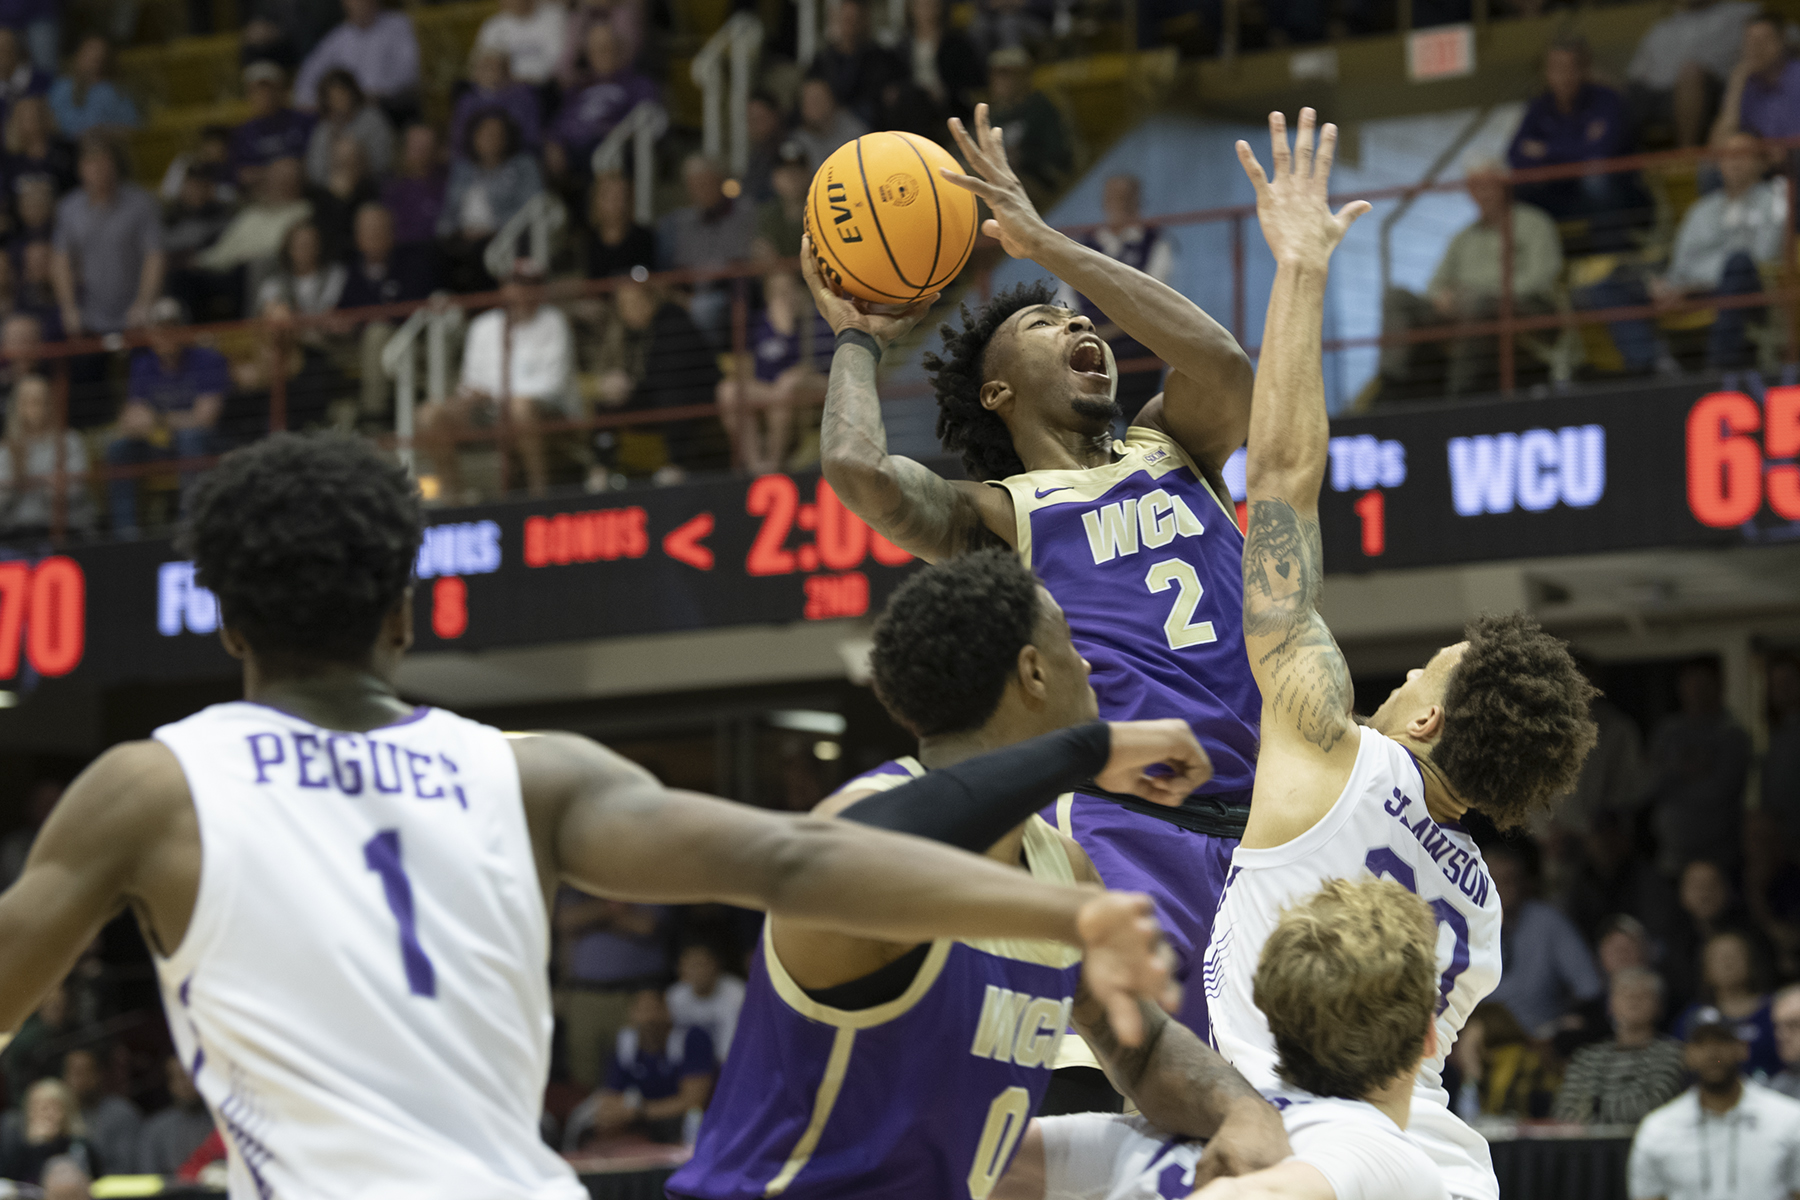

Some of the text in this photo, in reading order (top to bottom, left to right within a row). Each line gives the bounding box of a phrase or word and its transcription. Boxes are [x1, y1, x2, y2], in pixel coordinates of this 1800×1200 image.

[827, 183, 863, 243] EVO
[1448, 425, 1605, 516] WCU
[1685, 386, 1800, 529] 65
[524, 507, 648, 568] BONUS
[746, 474, 914, 576] 2:0
[1355, 489, 1385, 556] 1
[0, 555, 86, 678] 70
[1145, 557, 1217, 650] 2
[363, 829, 436, 998] 1
[967, 1086, 1031, 1200] 0
